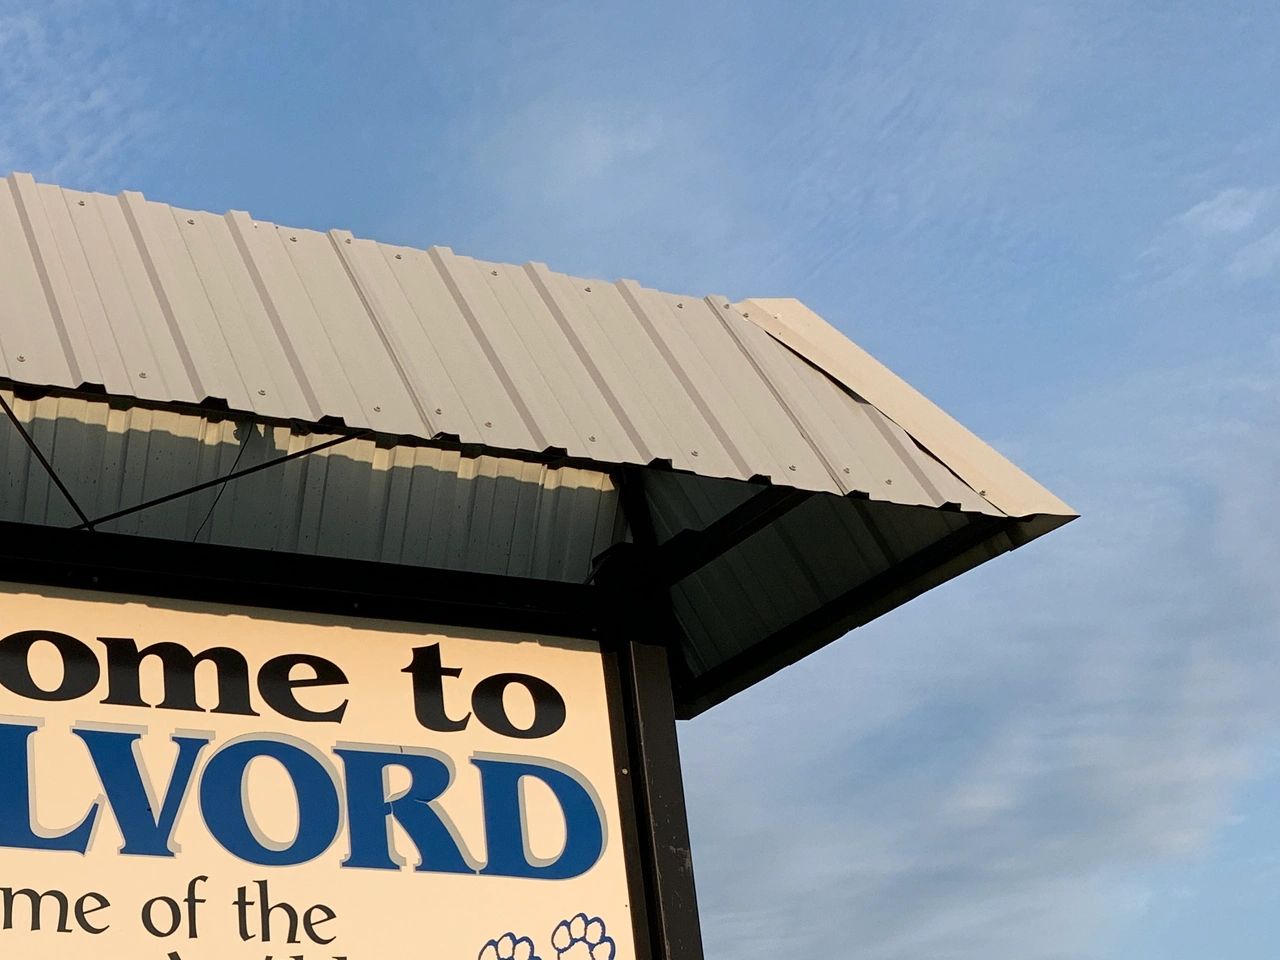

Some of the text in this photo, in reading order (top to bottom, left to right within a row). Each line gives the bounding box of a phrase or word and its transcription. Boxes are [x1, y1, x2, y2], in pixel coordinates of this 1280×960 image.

[401, 642, 566, 739] to
[142, 875, 208, 938] of
[232, 880, 336, 945] the
